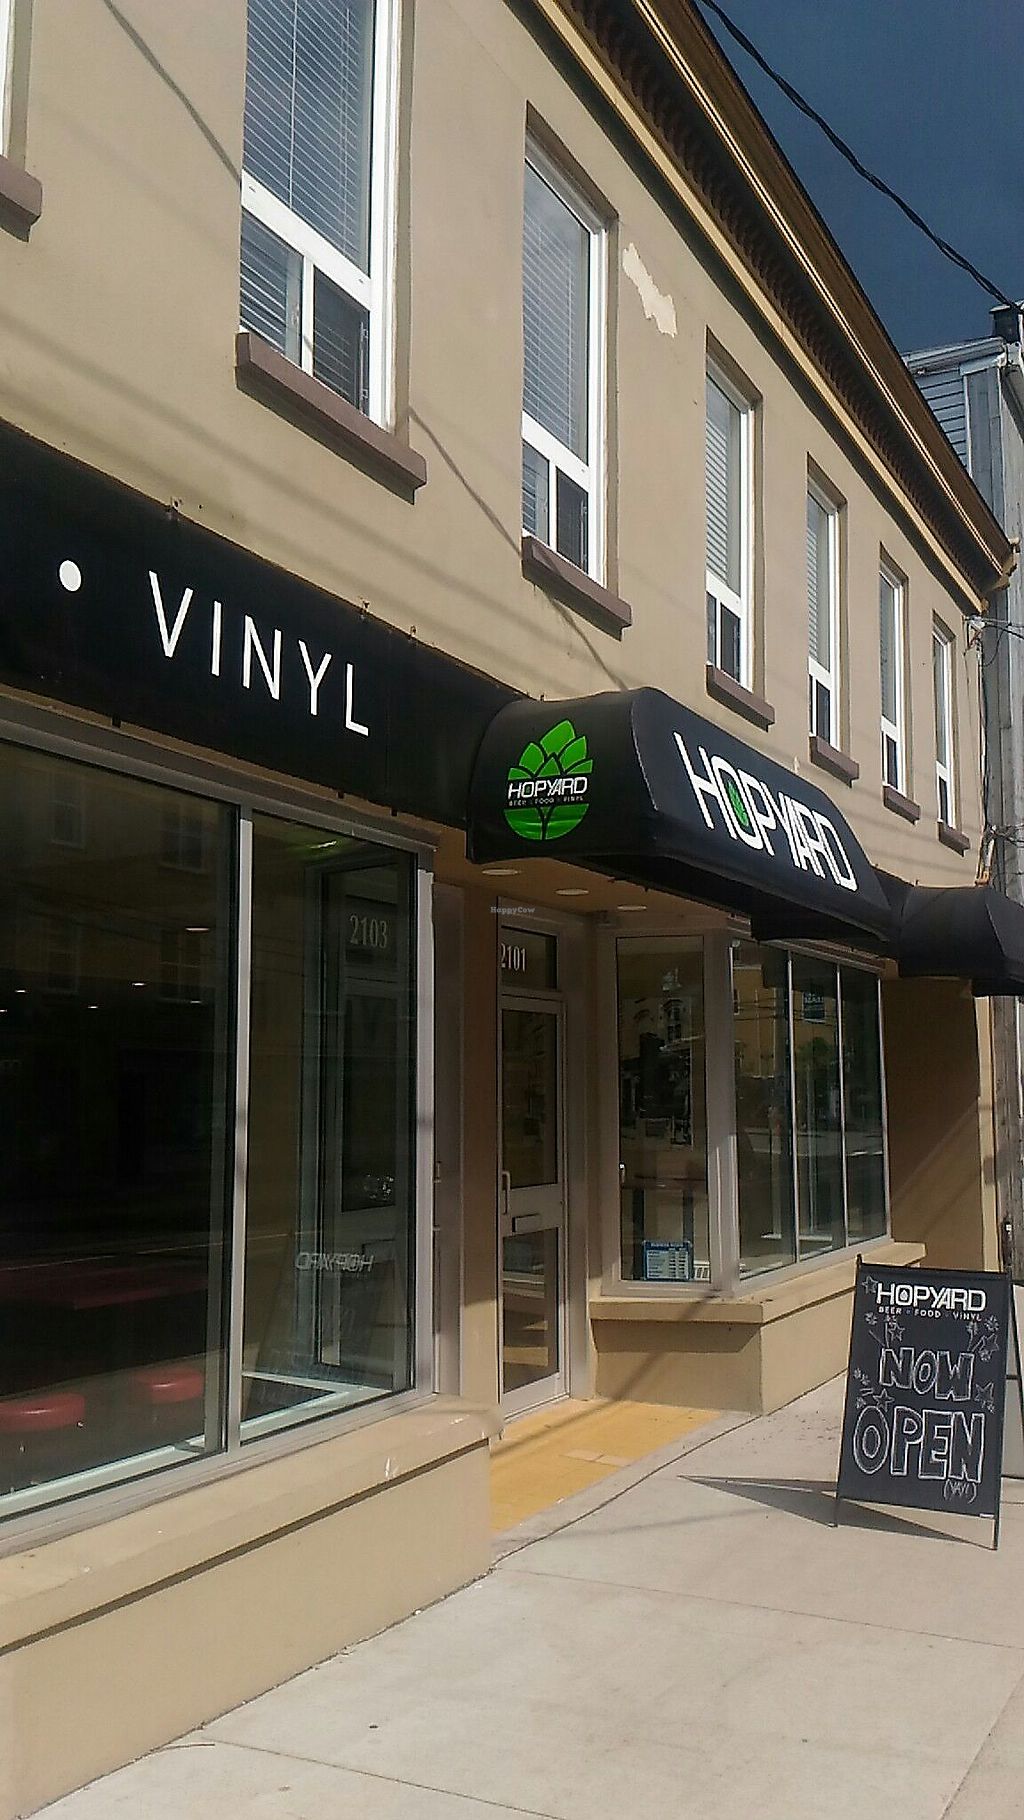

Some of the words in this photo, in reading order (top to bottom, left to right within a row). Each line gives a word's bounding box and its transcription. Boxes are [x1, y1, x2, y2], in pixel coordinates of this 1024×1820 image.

[149, 570, 369, 736] VINYL
[508, 776, 587, 799] HOPYARD
[673, 732, 858, 892] HOPYARD
[350, 915, 388, 949] 2103
[501, 942, 526, 974] 2101
[876, 1282, 986, 1312] HOPYARD
[878, 1306, 902, 1315] BEER
[914, 1308, 941, 1318] FOOD
[952, 1311, 982, 1322] VINYL
[879, 1347, 975, 1400] NOW
[853, 1405, 985, 1483] OPEN
